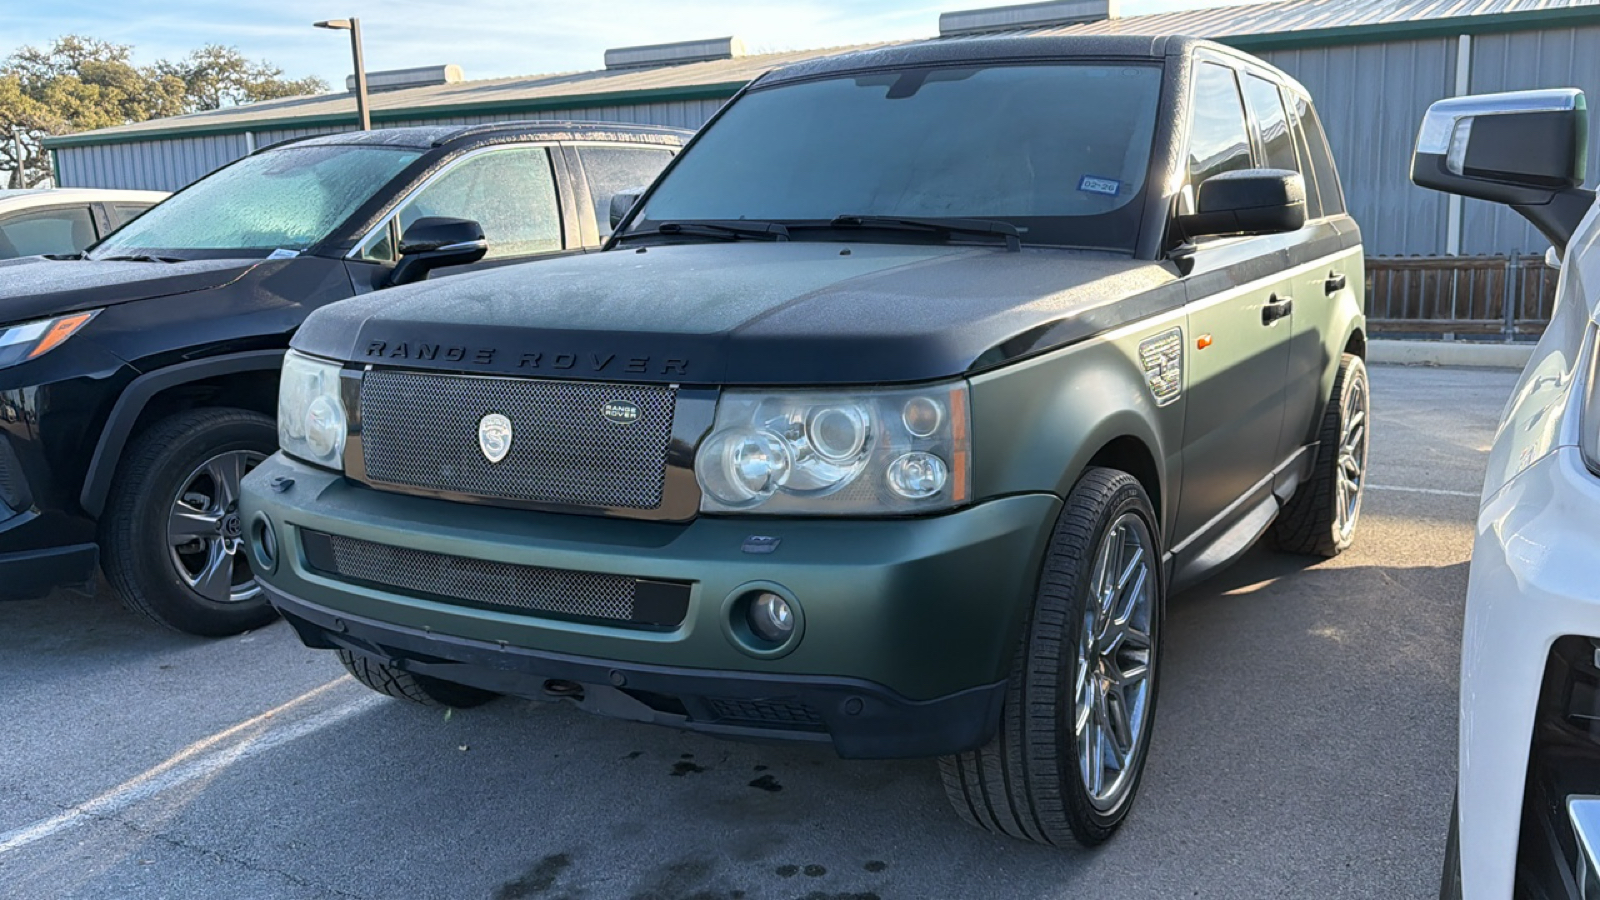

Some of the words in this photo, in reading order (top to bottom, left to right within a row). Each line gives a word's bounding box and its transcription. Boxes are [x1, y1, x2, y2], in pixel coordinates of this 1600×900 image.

[365, 339, 497, 365] RANGE
[516, 352, 690, 376] ROVER
[605, 404, 637, 413] RANGE
[605, 410, 637, 419] ROVER
